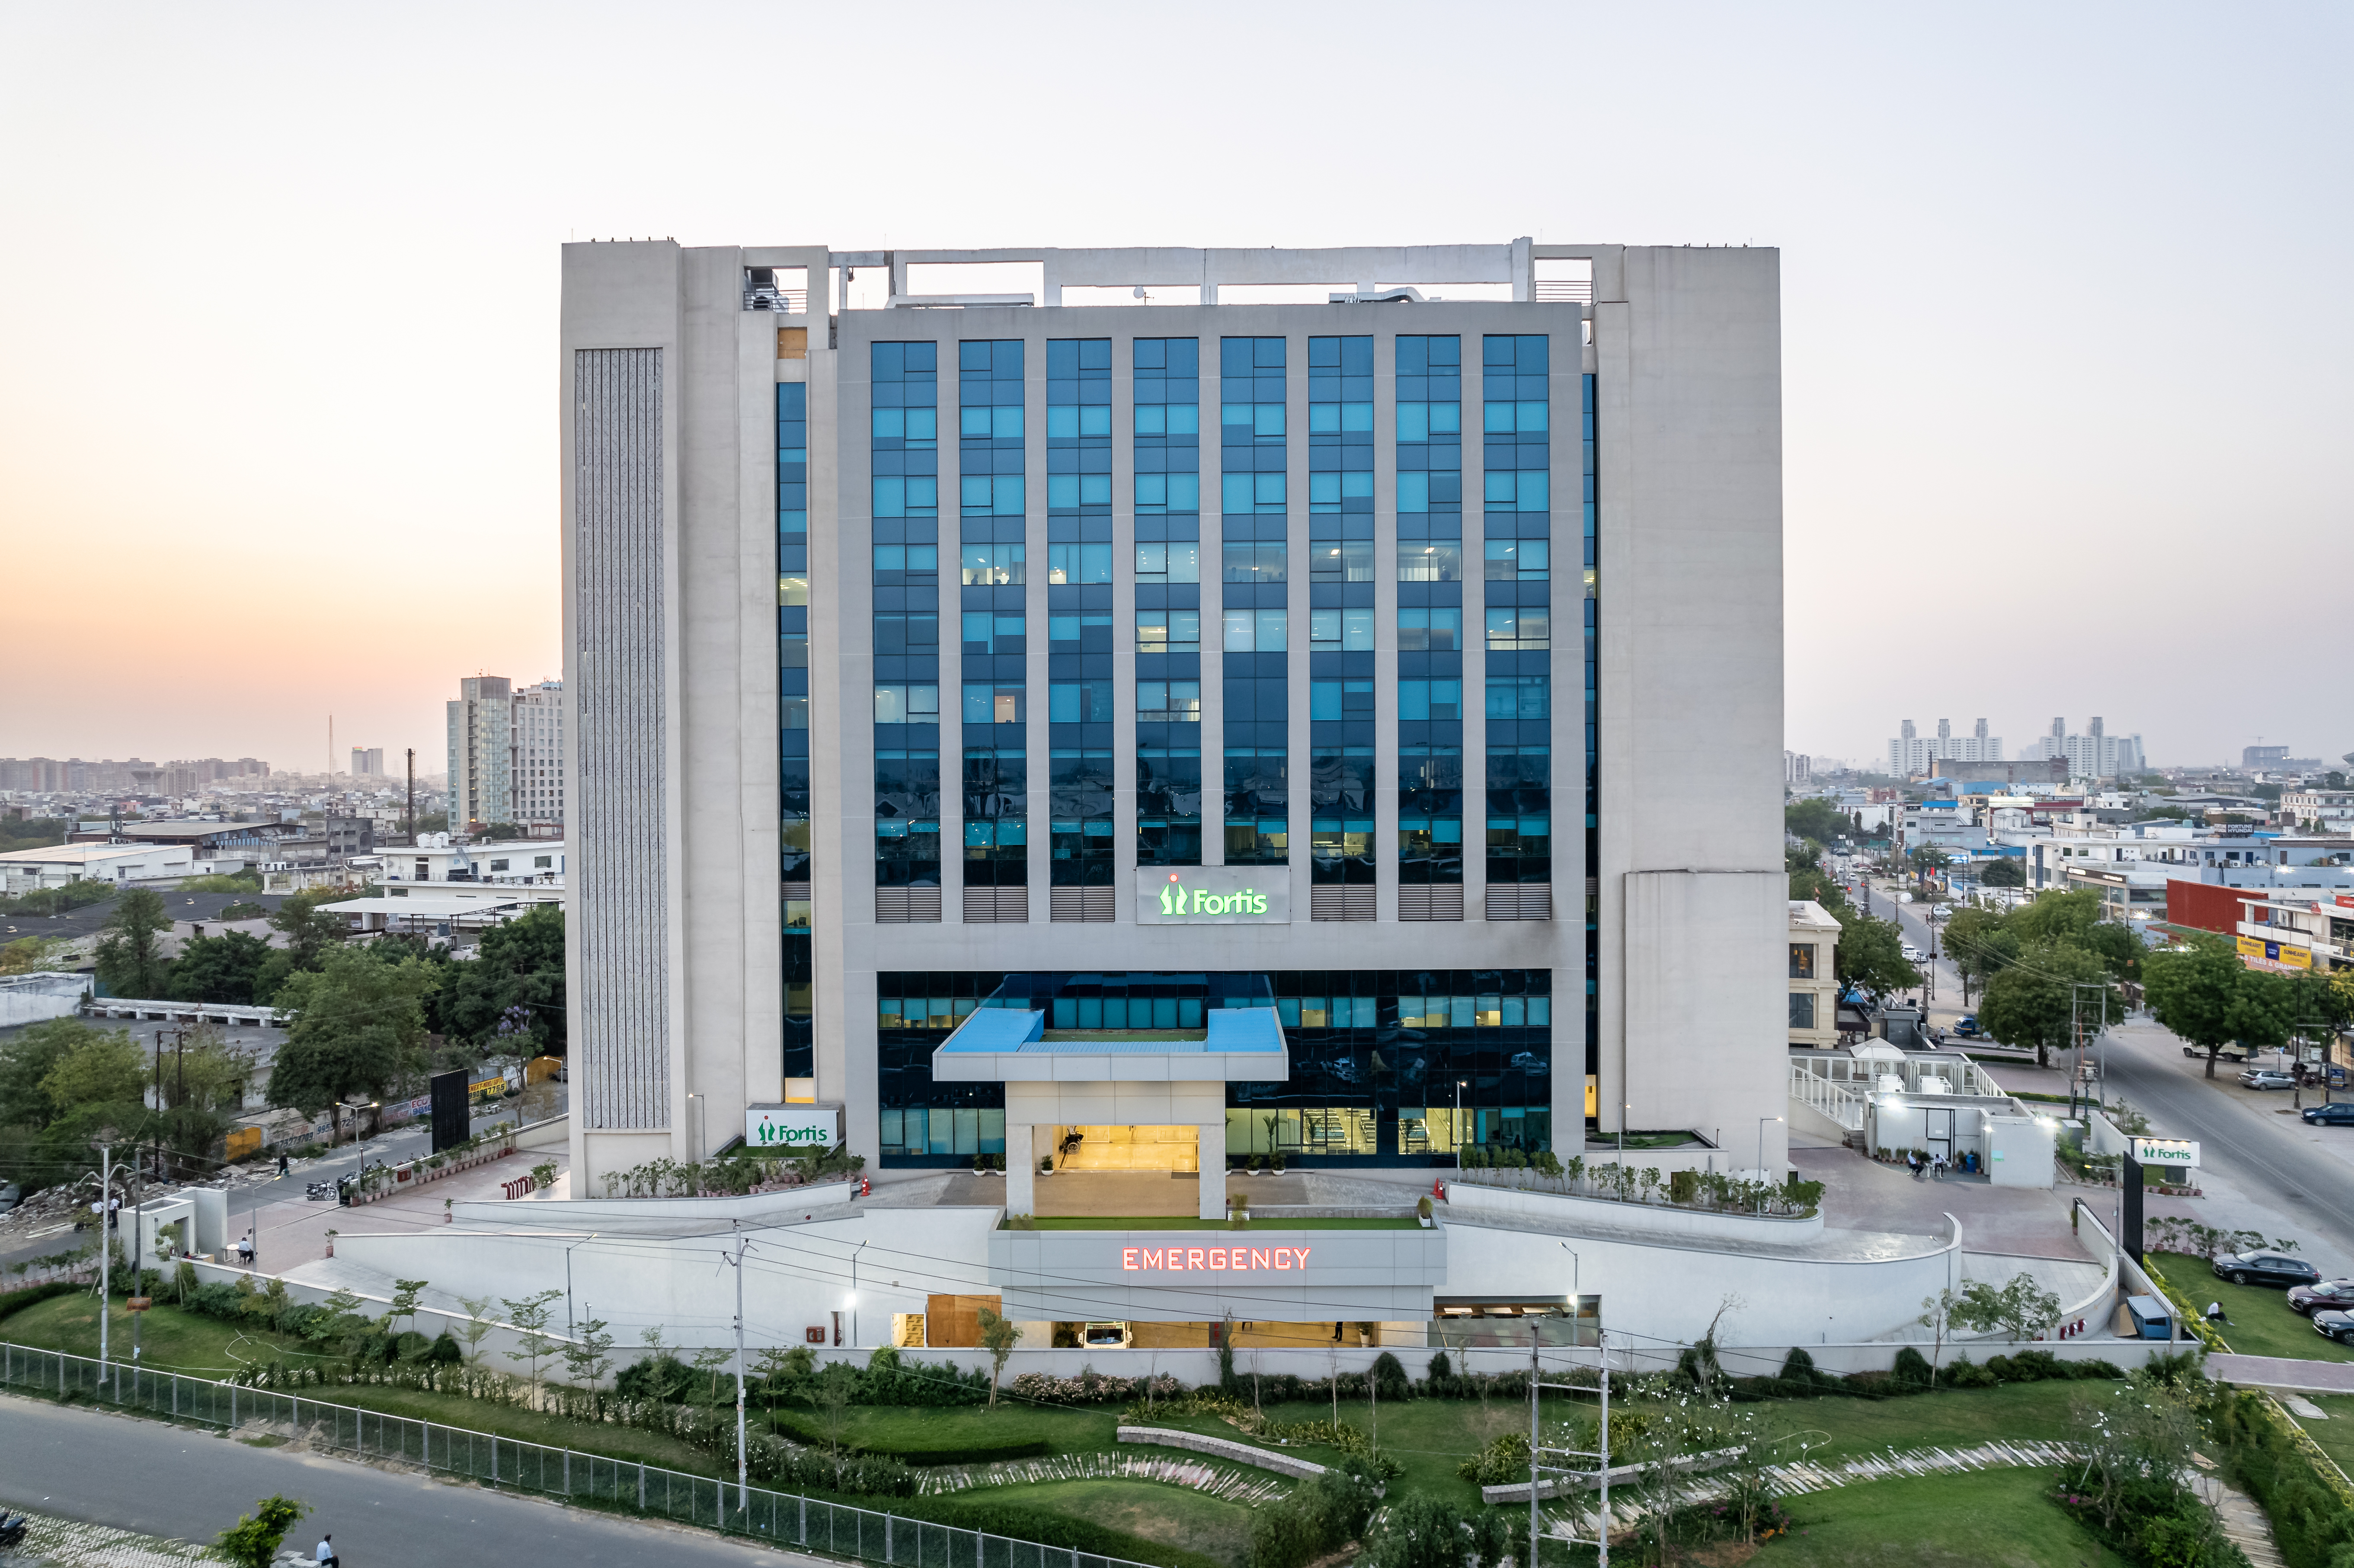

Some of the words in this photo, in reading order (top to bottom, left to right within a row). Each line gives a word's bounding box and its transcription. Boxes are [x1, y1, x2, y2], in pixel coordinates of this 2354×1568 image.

[1193, 888, 1268, 915] Fortis
[779, 1125, 827, 1141] Fortis
[2158, 1149, 2191, 1159] Fortis
[1123, 1248, 1311, 1270] EMERGENCY
